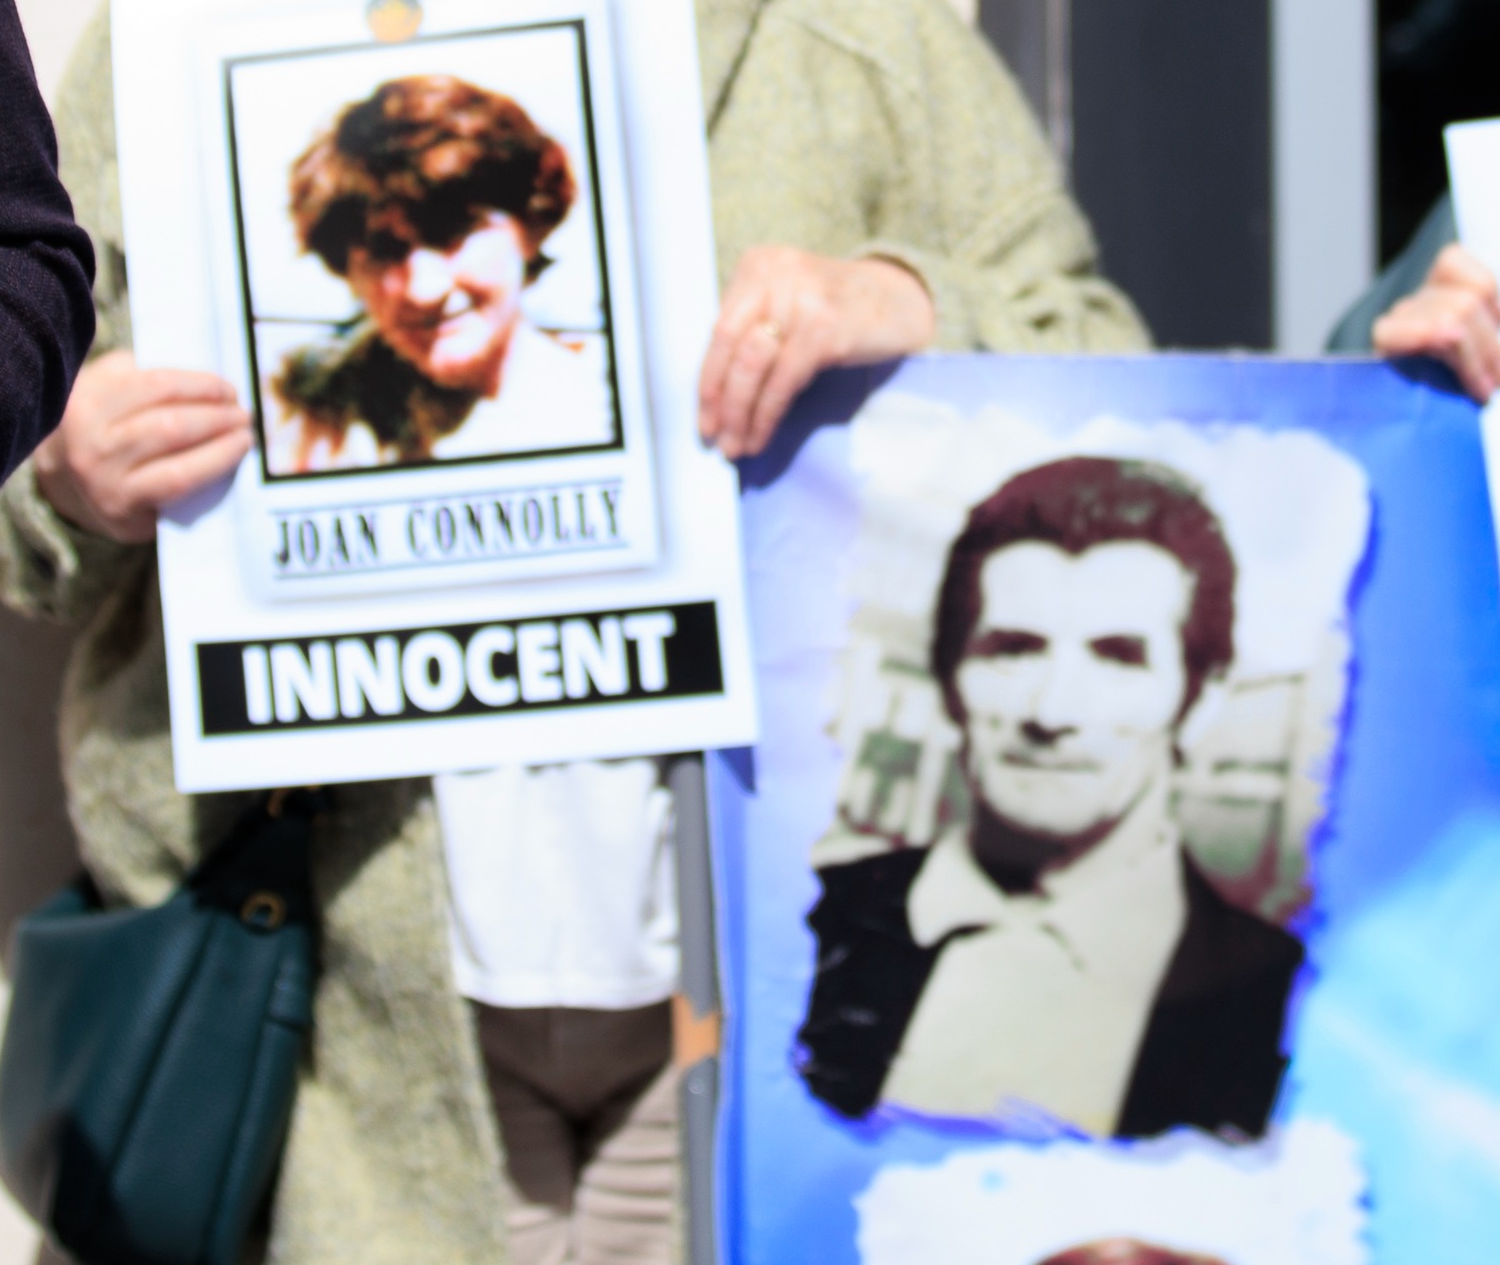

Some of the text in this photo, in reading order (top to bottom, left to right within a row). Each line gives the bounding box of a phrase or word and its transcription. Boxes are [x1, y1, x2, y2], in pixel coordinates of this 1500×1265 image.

[274, 487, 622, 568] JOAN CONNOLLY
[241, 610, 677, 725] INNOCENT
